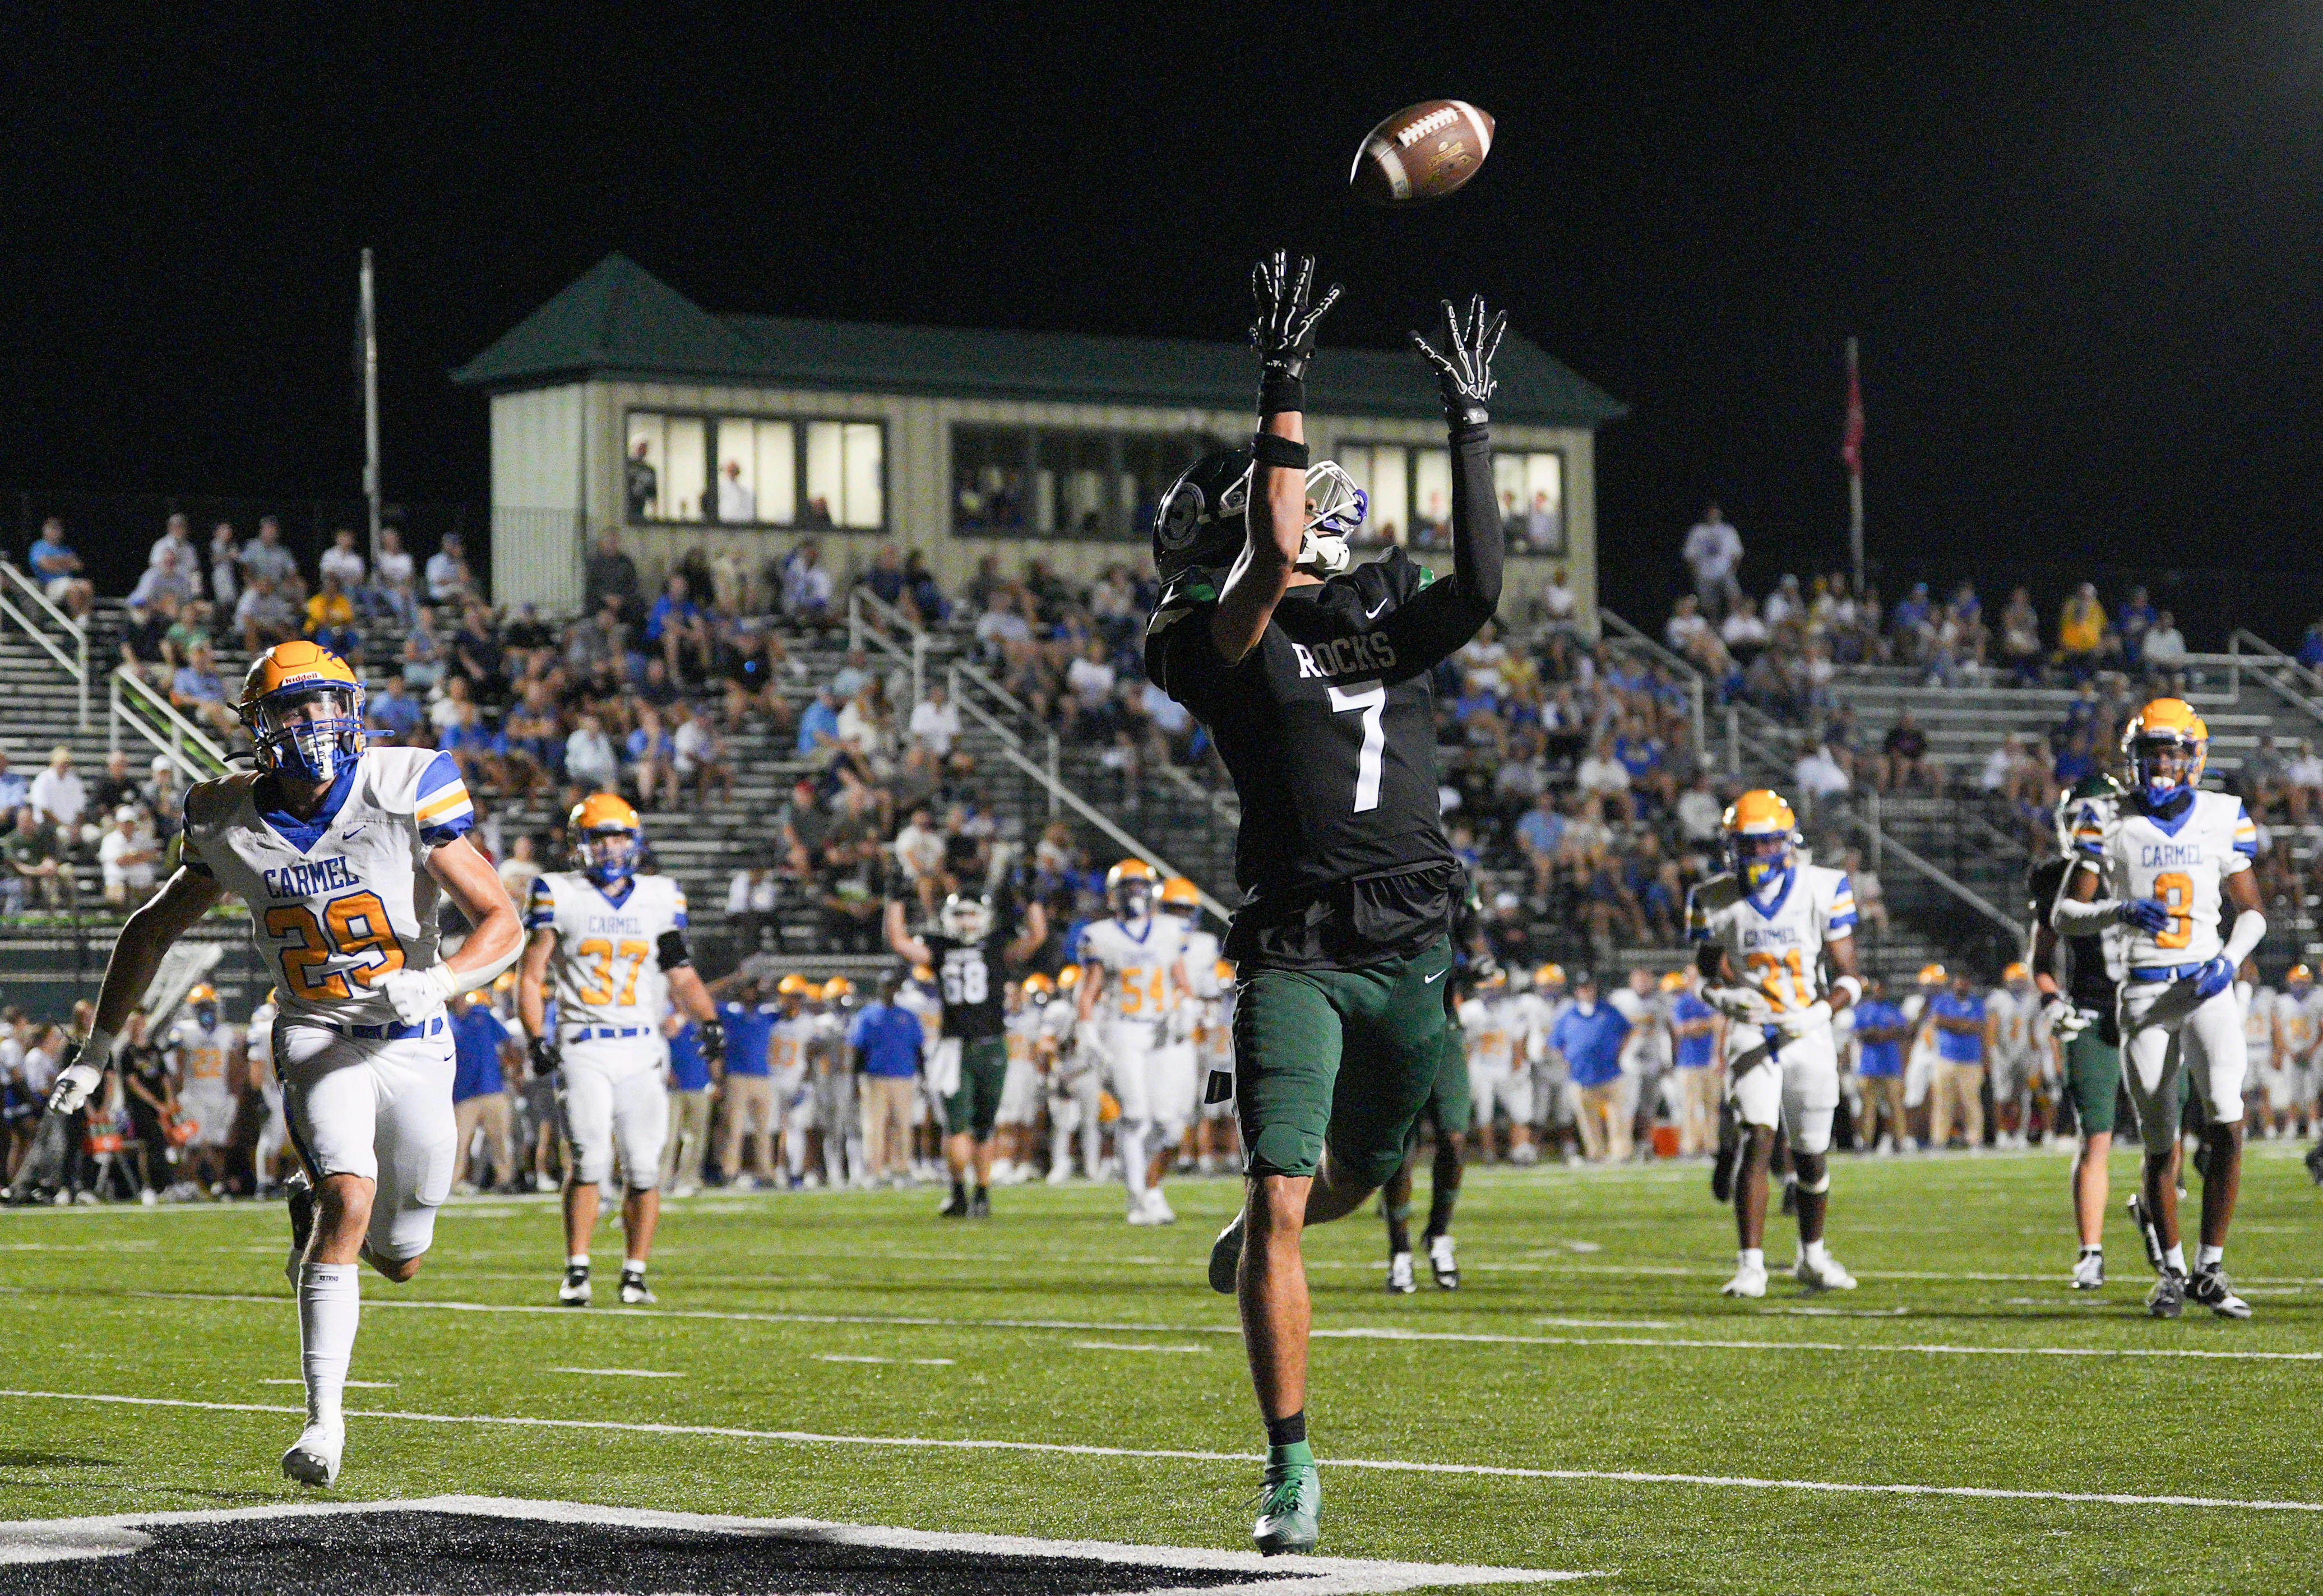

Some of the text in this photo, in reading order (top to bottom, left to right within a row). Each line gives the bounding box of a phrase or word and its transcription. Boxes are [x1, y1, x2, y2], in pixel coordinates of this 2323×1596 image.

[285, 673, 317, 683] Riddell
[1291, 631, 1396, 678] ROCKS
[1323, 678, 1386, 813] 7
[263, 855, 359, 899] CARMEL
[2141, 844, 2203, 867] CARMEL
[264, 889, 406, 1000] 29
[588, 915, 642, 935] CARMEL
[578, 938, 649, 1006] 37
[1119, 966, 1164, 1014] 54
